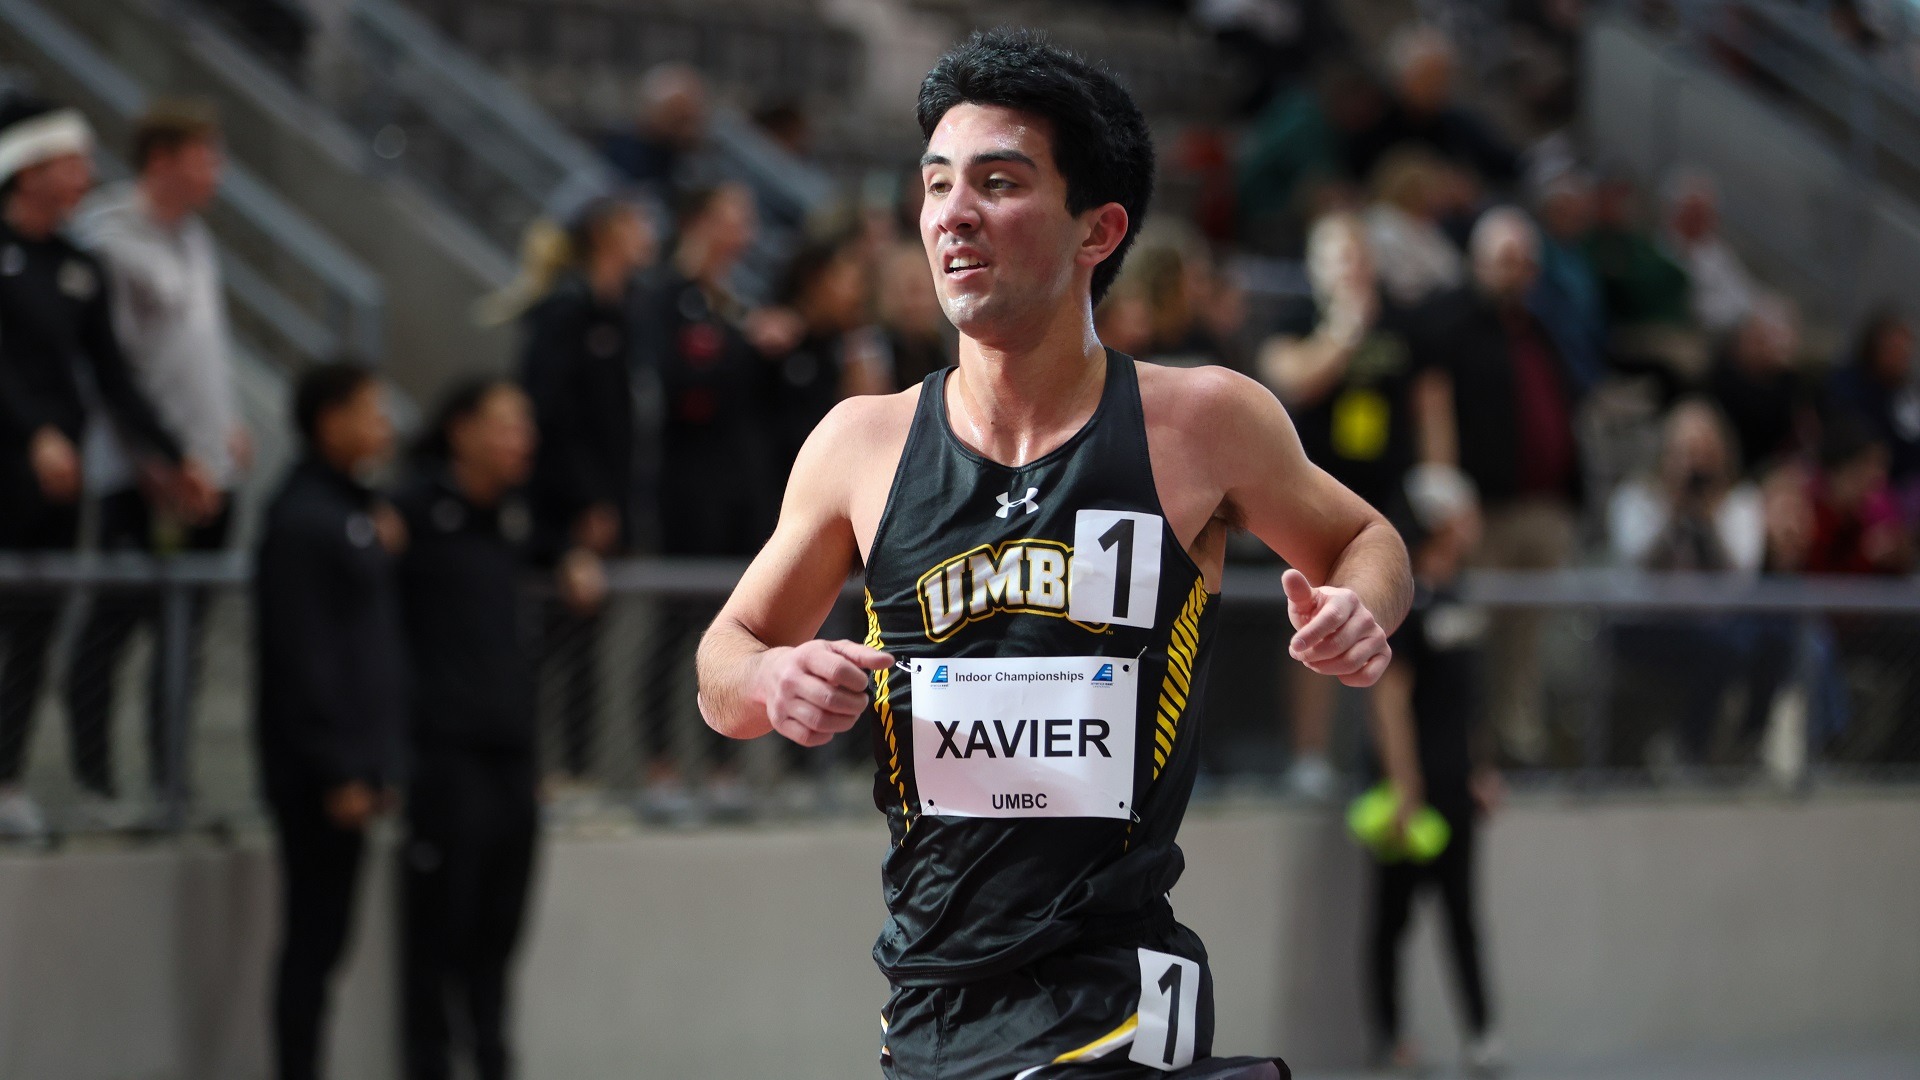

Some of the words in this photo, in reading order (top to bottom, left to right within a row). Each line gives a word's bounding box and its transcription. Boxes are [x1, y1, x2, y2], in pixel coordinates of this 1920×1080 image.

[918, 539, 1082, 643] UMB
[1097, 518, 1135, 619] 1
[955, 672, 992, 682] Indoor
[995, 671, 1084, 684] Championships
[934, 719, 1112, 759] XAVIER
[992, 793, 1048, 810] UMBC
[1157, 963, 1183, 1066] 1
